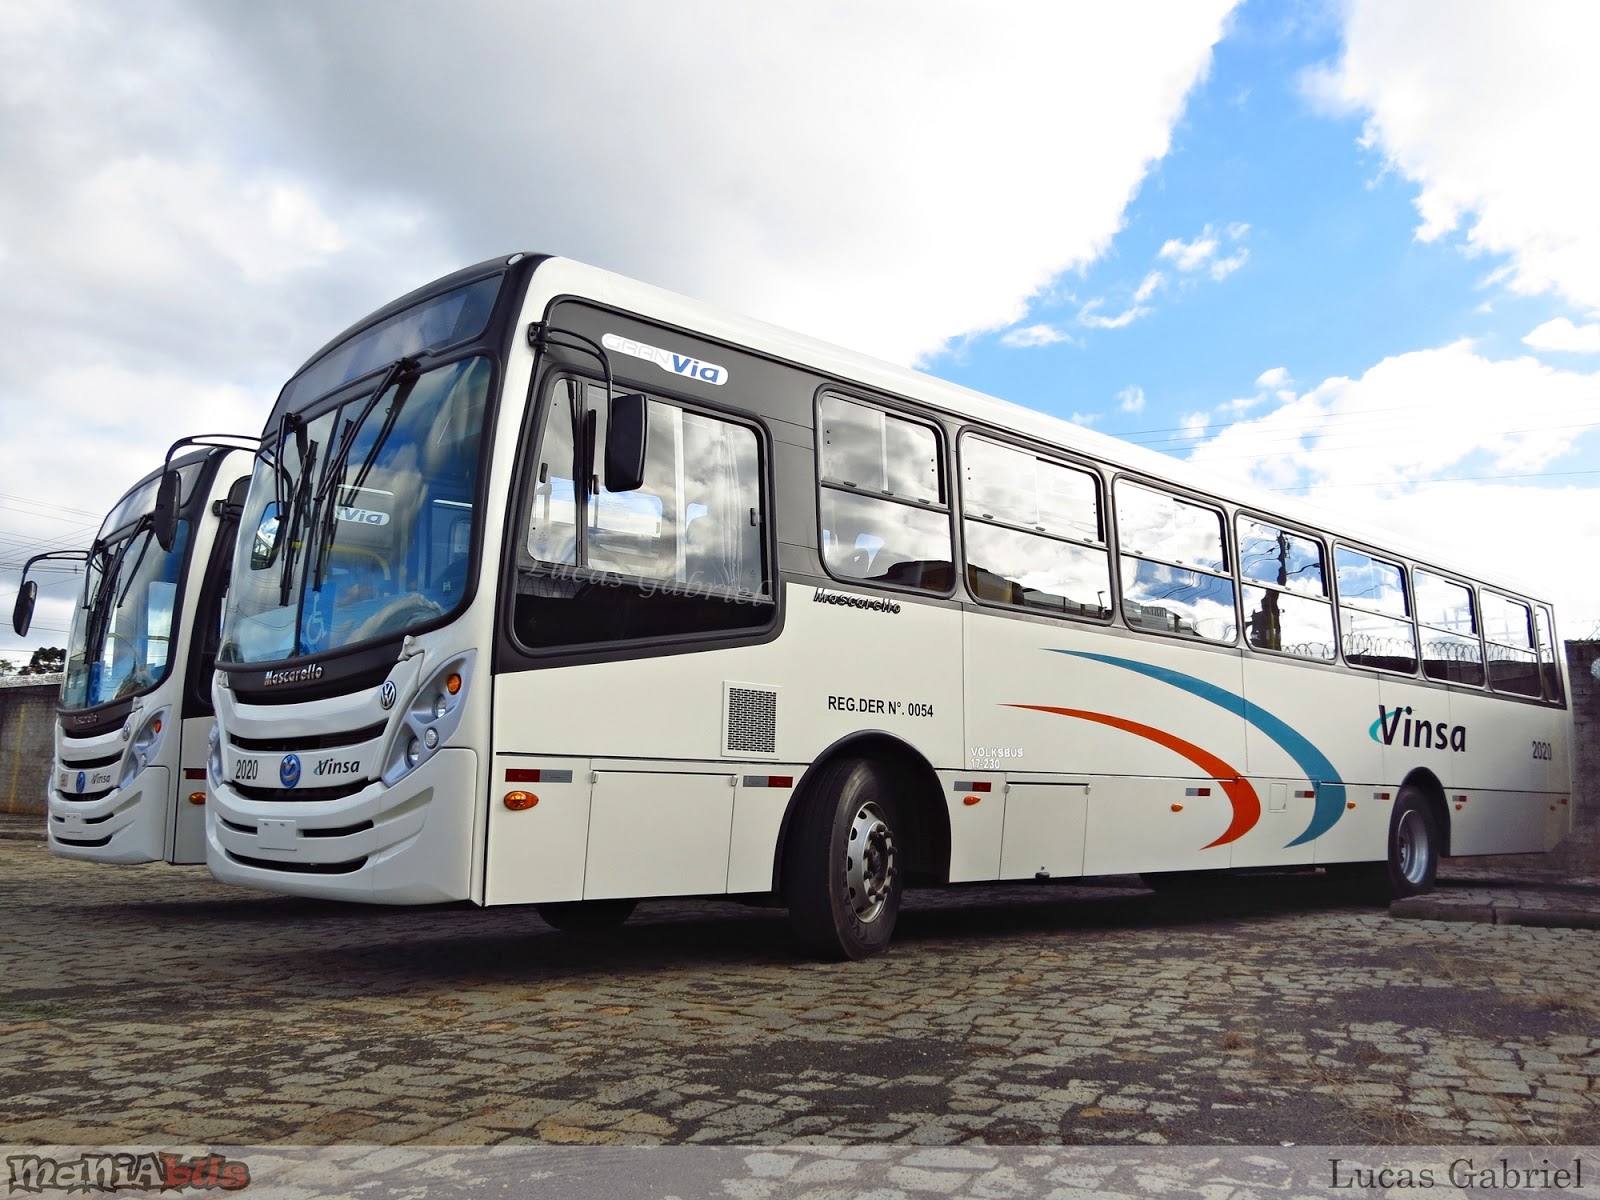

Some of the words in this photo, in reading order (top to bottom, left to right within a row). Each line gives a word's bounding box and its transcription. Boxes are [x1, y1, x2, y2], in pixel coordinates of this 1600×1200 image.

[813, 587, 901, 614] Mascarello
[264, 663, 324, 687] Mascarello
[908, 703, 934, 718] 0054
[1378, 704, 1467, 753] Vinsa
[970, 747, 1024, 758] VOLKSBUS
[1531, 740, 1552, 761] 2020
[235, 759, 259, 781] 2020
[317, 758, 361, 776] Vinsa
[970, 758, 1000, 769] 17-230
